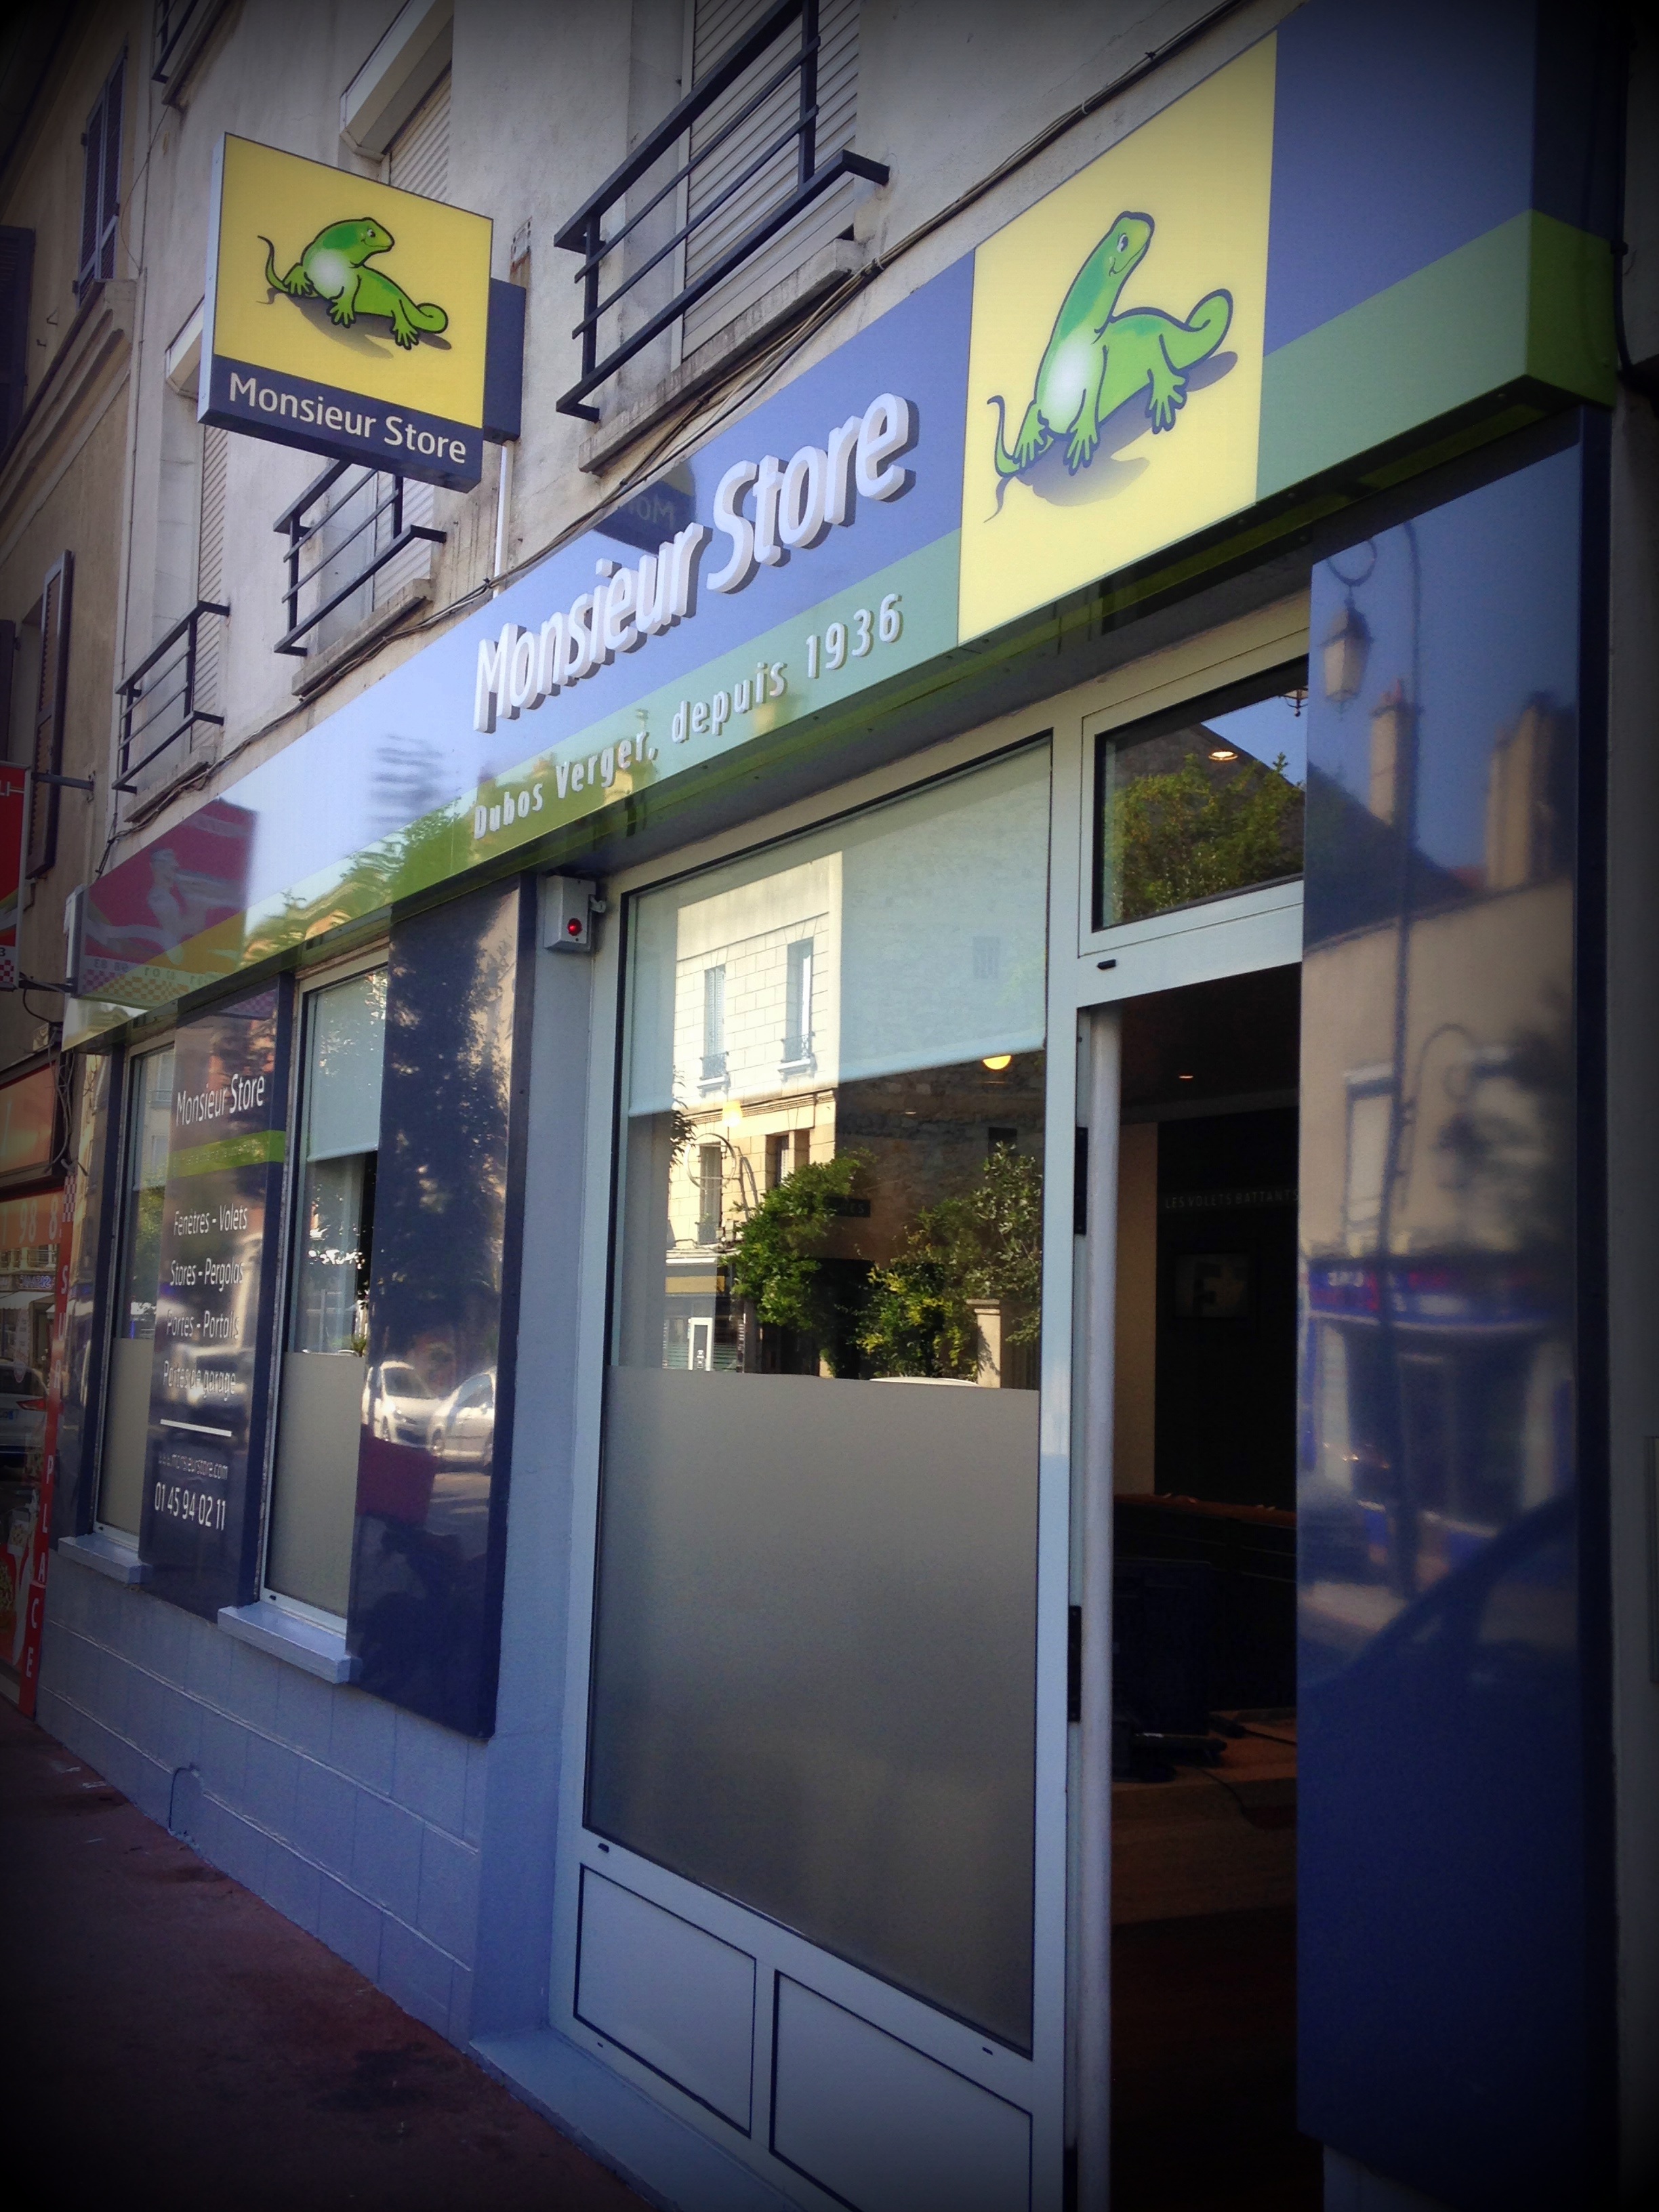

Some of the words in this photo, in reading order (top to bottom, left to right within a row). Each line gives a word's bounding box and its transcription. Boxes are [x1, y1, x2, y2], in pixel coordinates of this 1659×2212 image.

[228, 371, 376, 439] Monsieur
[384, 415, 467, 464] Store
[474, 523, 708, 733] Monsieur
[706, 392, 916, 594] Store
[473, 782, 544, 840] Dubos
[555, 729, 659, 800] Verger,
[671, 661, 787, 744] depuis
[805, 593, 903, 679] 1936
[176, 1083, 227, 1127] Monsieur
[229, 1073, 266, 1114] Store
[219, 1203, 248, 1232] Volets
[1164, 1195, 1185, 1210] LES
[1187, 1193, 1232, 1208] VOLETS
[169, 1259, 197, 1287] Stores
[204, 1256, 245, 1293] Pergolas
[166, 1309, 194, 1338] Portes
[203, 1309, 240, 1340] Portails
[163, 1359, 190, 1389] Portes
[203, 1369, 237, 1401] garage
[154, 1481, 166, 1512] 01
[167, 1486, 181, 1517] 45
[182, 1489, 196, 1521] 94
[198, 1493, 213, 1528] 02
[216, 1498, 226, 1532] 11
